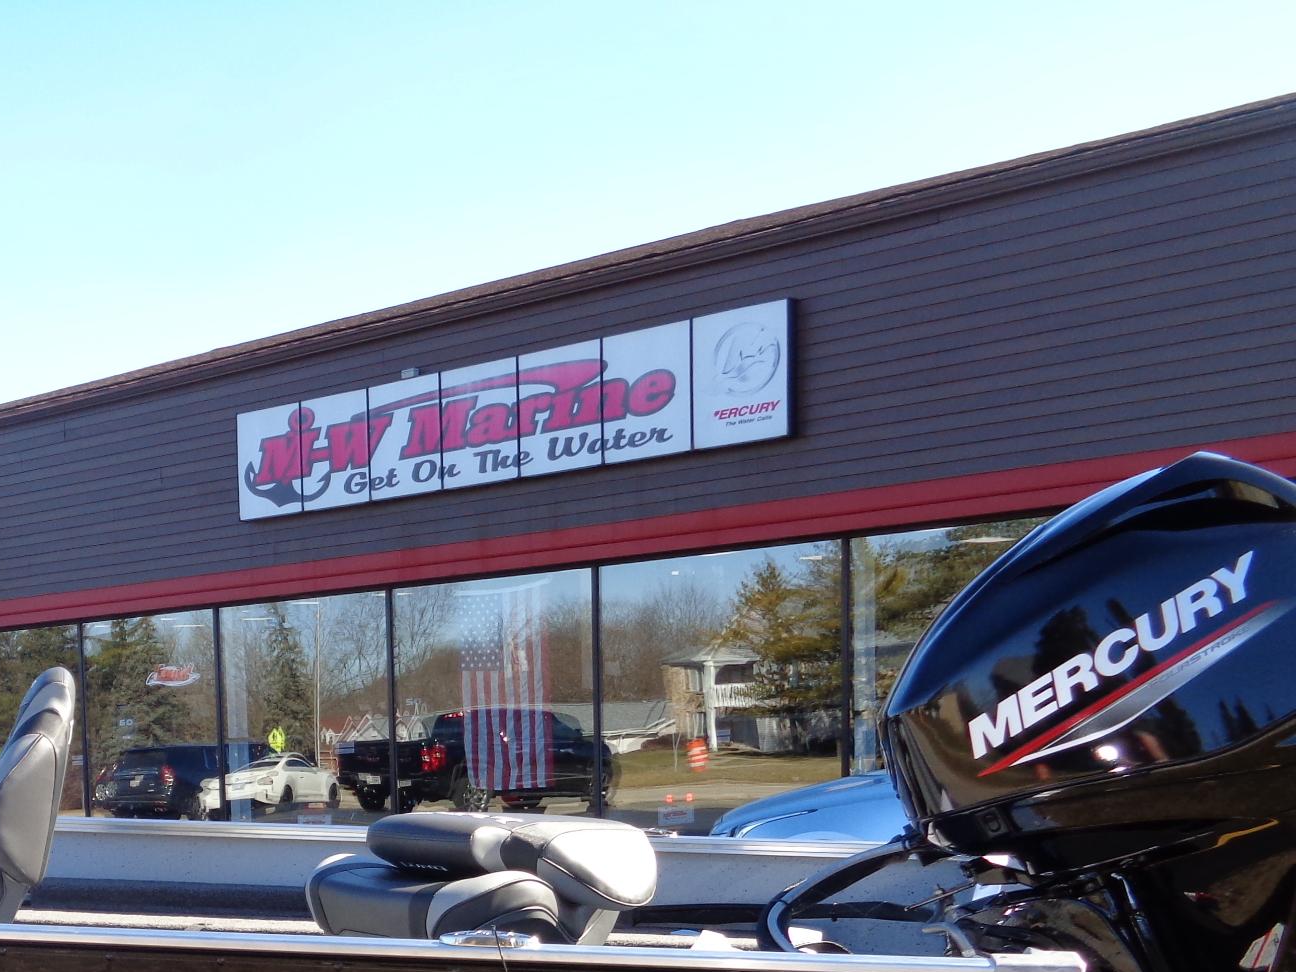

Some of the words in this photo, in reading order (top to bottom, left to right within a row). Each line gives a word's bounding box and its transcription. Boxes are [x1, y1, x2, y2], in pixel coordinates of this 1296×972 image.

[255, 411, 394, 486] M-W
[399, 369, 676, 460] Marine
[344, 468, 400, 494] Get
[411, 459, 461, 482] On
[473, 448, 533, 473] The
[547, 426, 673, 460] Water
[968, 550, 1254, 759] MERCURY
